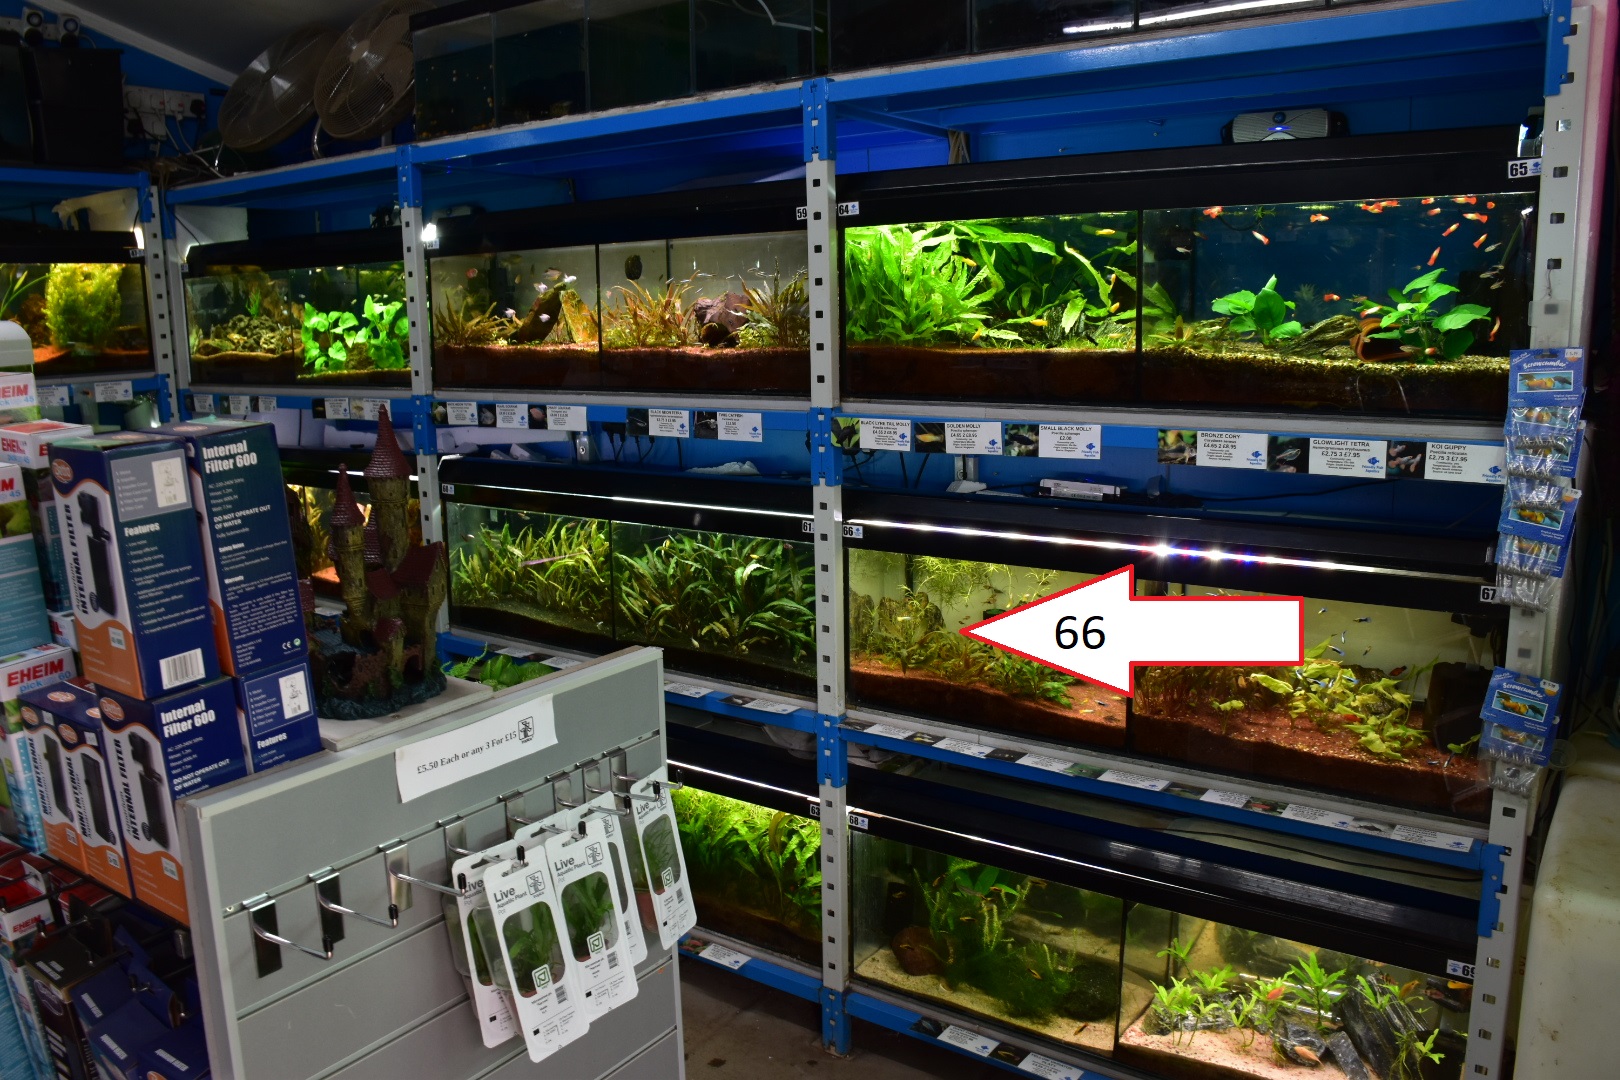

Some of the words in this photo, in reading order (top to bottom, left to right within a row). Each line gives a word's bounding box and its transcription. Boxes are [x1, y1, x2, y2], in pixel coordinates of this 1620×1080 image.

[1510, 162, 1528, 177] 65
[797, 208, 807, 219] 59
[839, 204, 849, 215] 64
[0, 384, 28, 399] EIM
[202, 440, 248, 460] Internal
[204, 458, 234, 474] Filter
[235, 452, 258, 468] 600
[223, 513, 234, 521] NOT
[235, 506, 259, 517] OPERATE
[259, 504, 271, 512] OUT
[64, 504, 79, 549] FILTER
[124, 522, 161, 537] Features
[223, 519, 242, 528] WATER
[803, 521, 812, 532] 61
[843, 526, 853, 537] 66
[72, 550, 89, 615] INTERNAL
[1482, 587, 1496, 601] 67
[7, 658, 64, 688] EHEIM
[20, 681, 43, 693] pick
[58, 670, 72, 681] 60
[160, 698, 206, 725] Internal
[163, 718, 193, 738] Filter
[193, 709, 216, 727] 600
[257, 732, 288, 750] Features
[113, 738, 128, 781] FILTER
[417, 760, 439, 774] £5.50
[440, 753, 460, 767] Each
[461, 751, 470, 759] or
[471, 745, 484, 756] any
[485, 741, 490, 750] 3
[491, 737, 504, 748] For
[504, 731, 517, 742] £15
[28, 737, 43, 789] INTERNAL
[184, 772, 195, 782] NOT
[194, 763, 218, 776] OPERATE
[218, 758, 230, 767] OUT
[65, 756, 80, 810] INTERNAL
[183, 777, 202, 788] WATER
[39, 790, 49, 816] MINI
[121, 781, 140, 841] INTERNAL
[636, 802, 649, 815] Live
[811, 805, 820, 816] 63
[76, 811, 88, 838] MINI
[849, 815, 859, 826] 68
[554, 857, 575, 872] Live
[557, 866, 574, 877] Aquatic
[574, 861, 586, 869] Plant
[463, 890, 482, 900] Aquatic
[493, 887, 516, 903] Live
[497, 897, 514, 909] Aquatic
[514, 891, 528, 901] Plant
